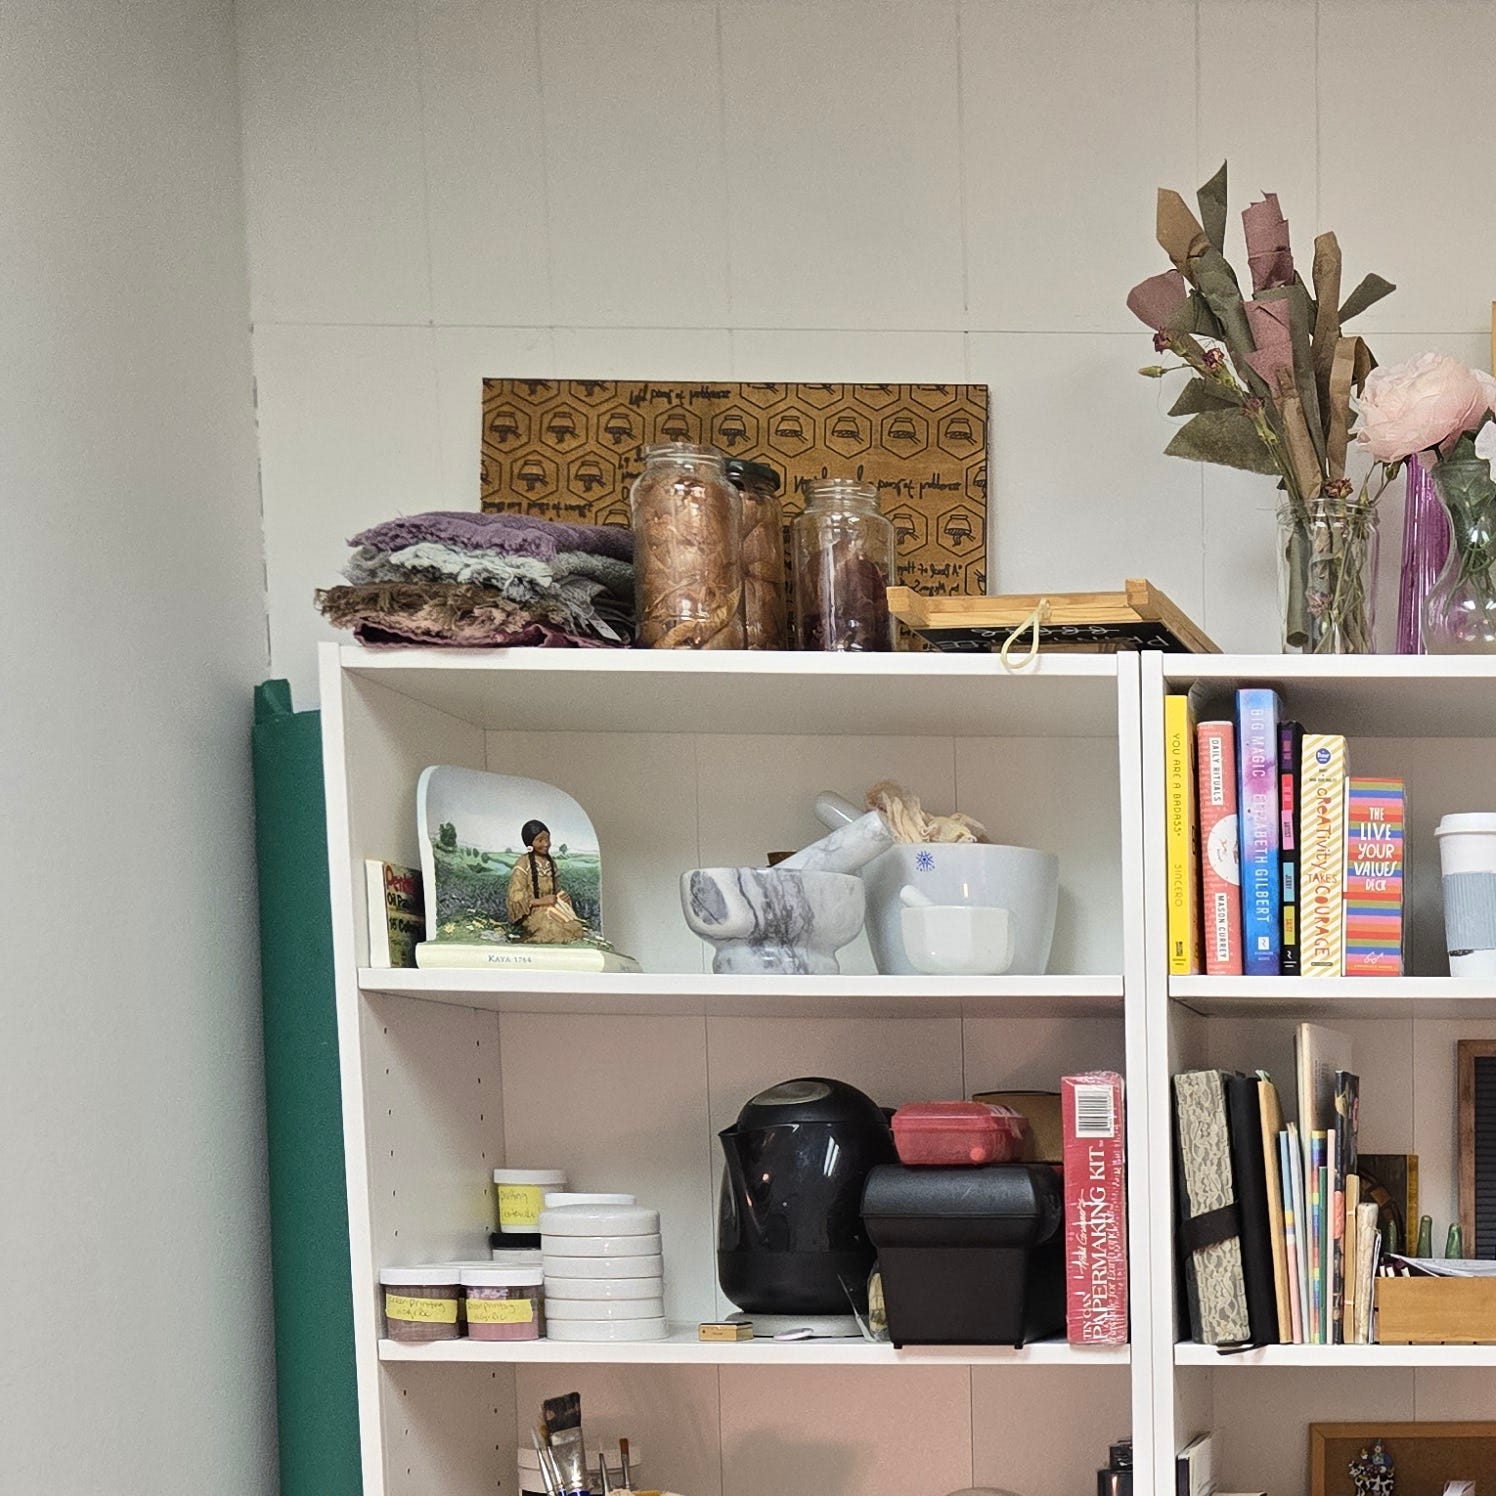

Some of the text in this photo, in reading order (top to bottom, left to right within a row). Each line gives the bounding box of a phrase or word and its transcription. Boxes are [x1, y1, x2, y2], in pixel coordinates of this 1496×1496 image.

[1172, 734, 1181, 756] YOU
[1250, 708, 1265, 777] BIG MAGIC
[1173, 760, 1181, 778] ARE
[1211, 740, 1221, 802] DAILY RITUALS
[1369, 807, 1385, 820] THE
[1360, 824, 1391, 841] LIVE
[1358, 843, 1394, 859] YOUR
[1308, 873, 1337, 884] TAKES
[1354, 861, 1397, 876] VALUES
[1365, 878, 1386, 891] DECK
[1255, 869, 1270, 922] GILBERT
[1217, 895, 1227, 958] MASON CURREY
[1314, 885, 1331, 957] COURAGE
[1089, 1146, 1107, 1340] PAPERMAKING KIT
